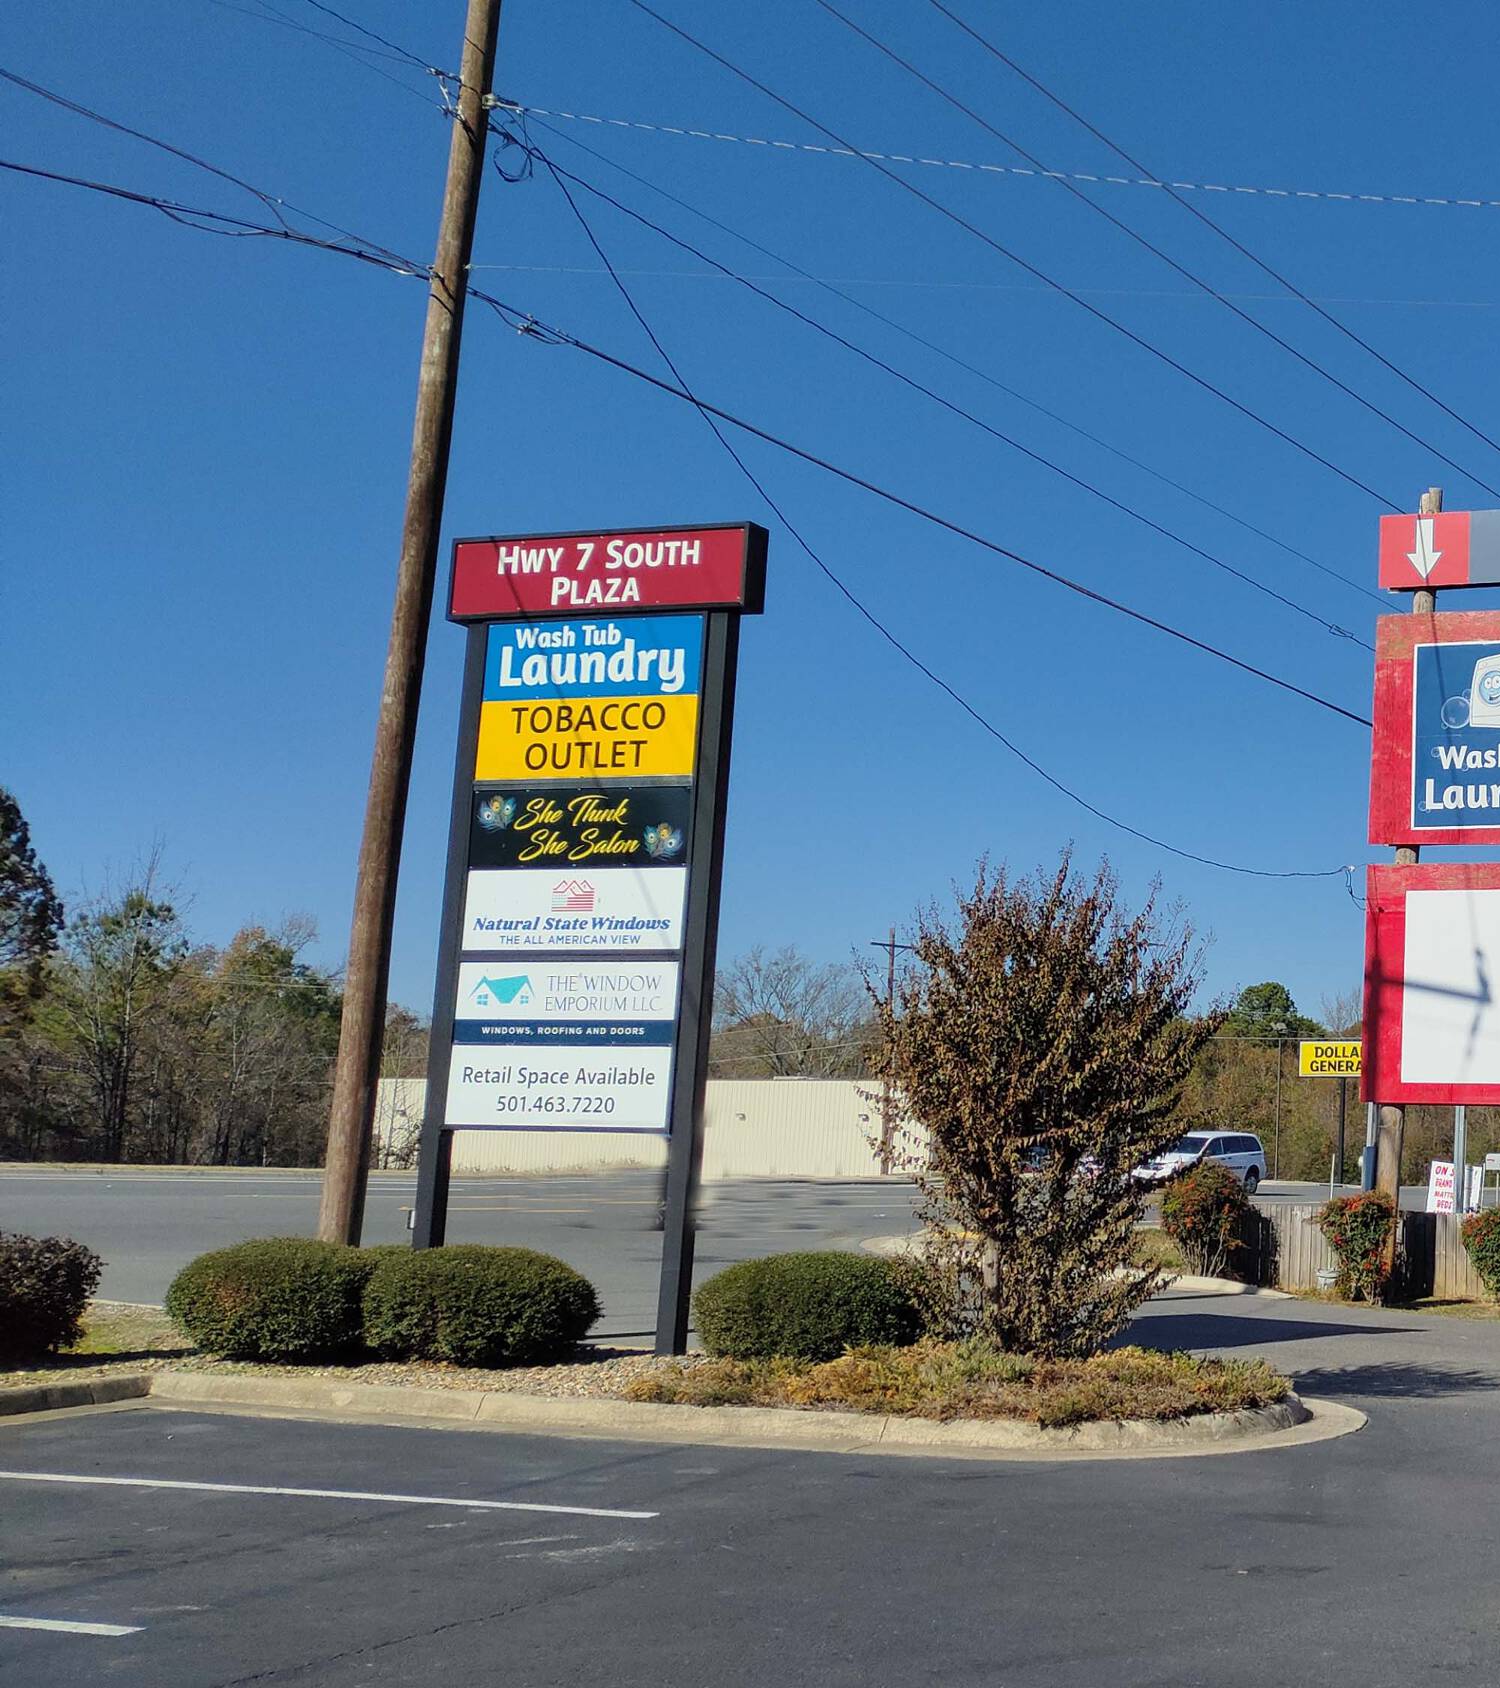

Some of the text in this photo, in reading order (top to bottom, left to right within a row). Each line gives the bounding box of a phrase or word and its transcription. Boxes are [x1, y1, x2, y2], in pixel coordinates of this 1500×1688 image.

[497, 539, 700, 575] HWY 7 SOUTH
[551, 576, 640, 605] PLAZA
[516, 624, 622, 649] Wash Tub
[499, 638, 686, 692] Laundry
[511, 702, 665, 734] TOBACCO
[525, 740, 648, 770] OUTLET
[514, 794, 629, 831] She Think
[518, 828, 640, 862] She Salon
[473, 916, 670, 931] Natural State Windows
[500, 935, 641, 945] THE ALL AMERICAN VIEW
[547, 975, 662, 991] THE WINDOW
[545, 996, 662, 1012] EMPORIUM LLC
[481, 1026, 645, 1036] WINDOWS, ROOFING AND DOORS
[1314, 1046, 1362, 1058] DOLLA
[462, 1066, 655, 1088] Retail Space Available
[1310, 1060, 1361, 1072] GENERA
[496, 1096, 615, 1114] 501.463.7220
